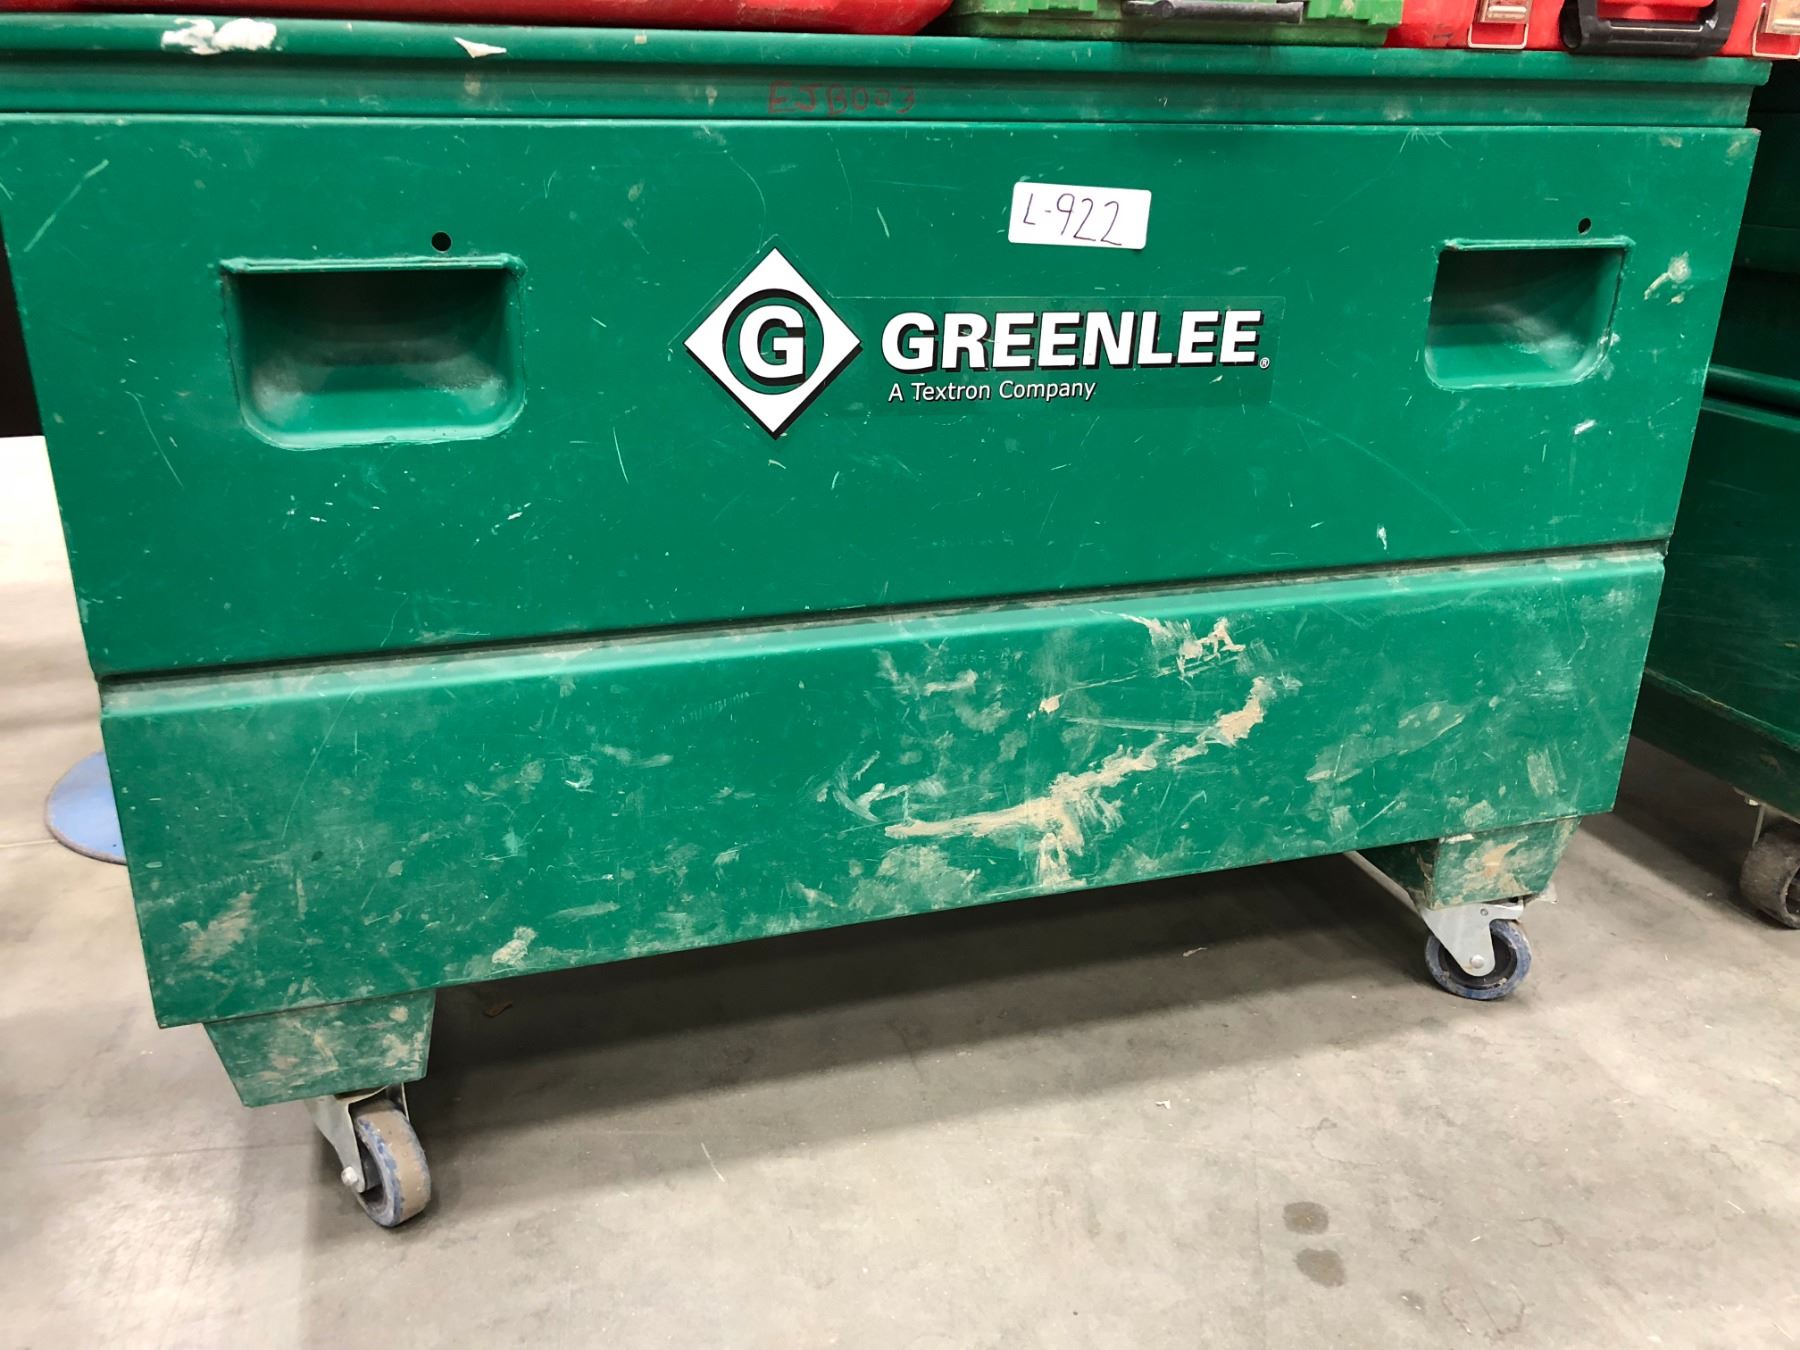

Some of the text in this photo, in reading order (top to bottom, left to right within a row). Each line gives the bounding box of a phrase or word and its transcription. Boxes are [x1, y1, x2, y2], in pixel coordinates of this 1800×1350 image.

[1023, 193, 1122, 246] L-922
[738, 304, 806, 382] G
[881, 310, 1264, 373] GREENLEE
[888, 380, 1097, 402] A Textron Company
